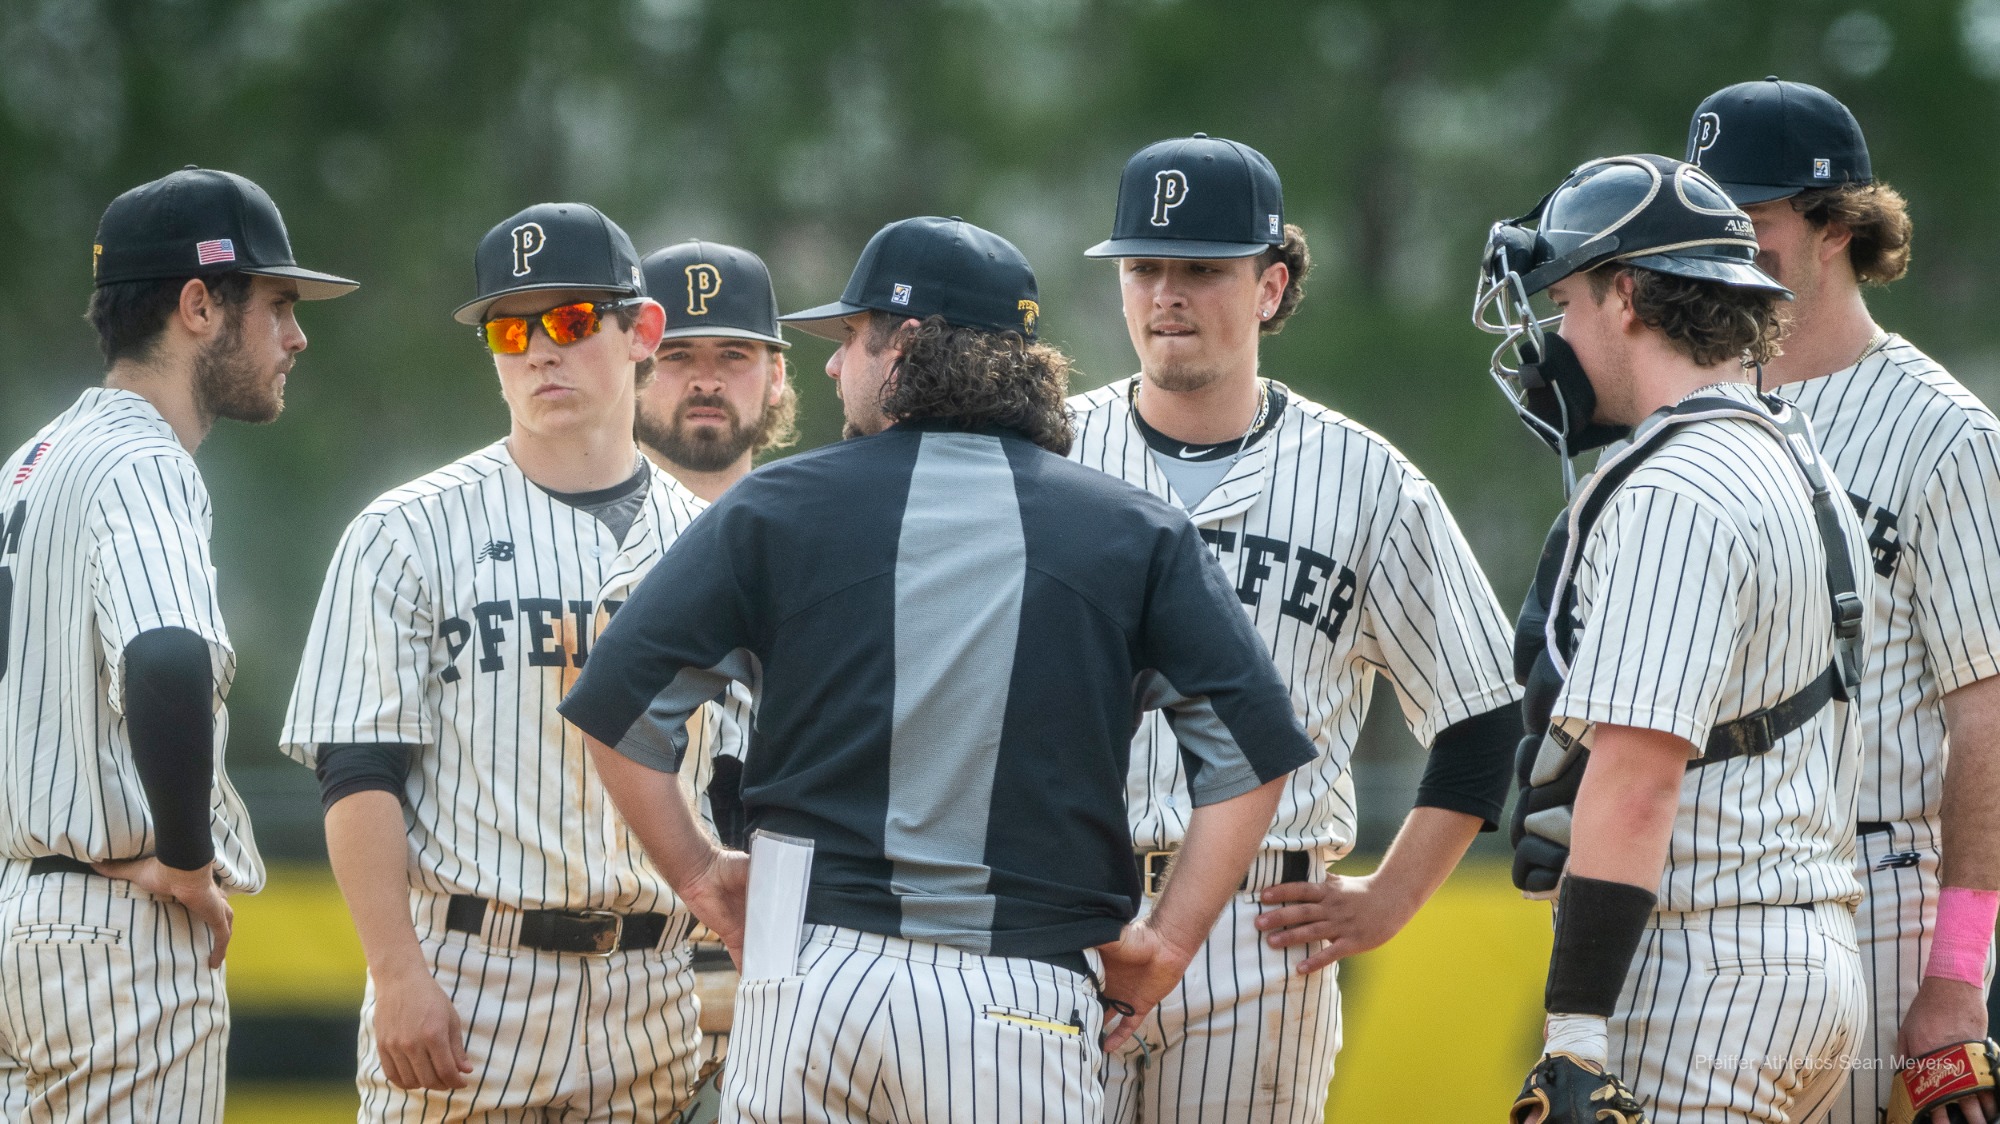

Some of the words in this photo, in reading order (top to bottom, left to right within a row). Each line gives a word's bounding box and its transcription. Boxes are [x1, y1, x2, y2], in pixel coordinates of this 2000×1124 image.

[1690, 112, 1720, 167] P
[1151, 169, 1189, 226] P
[511, 222, 546, 276] P
[684, 263, 722, 316] P
